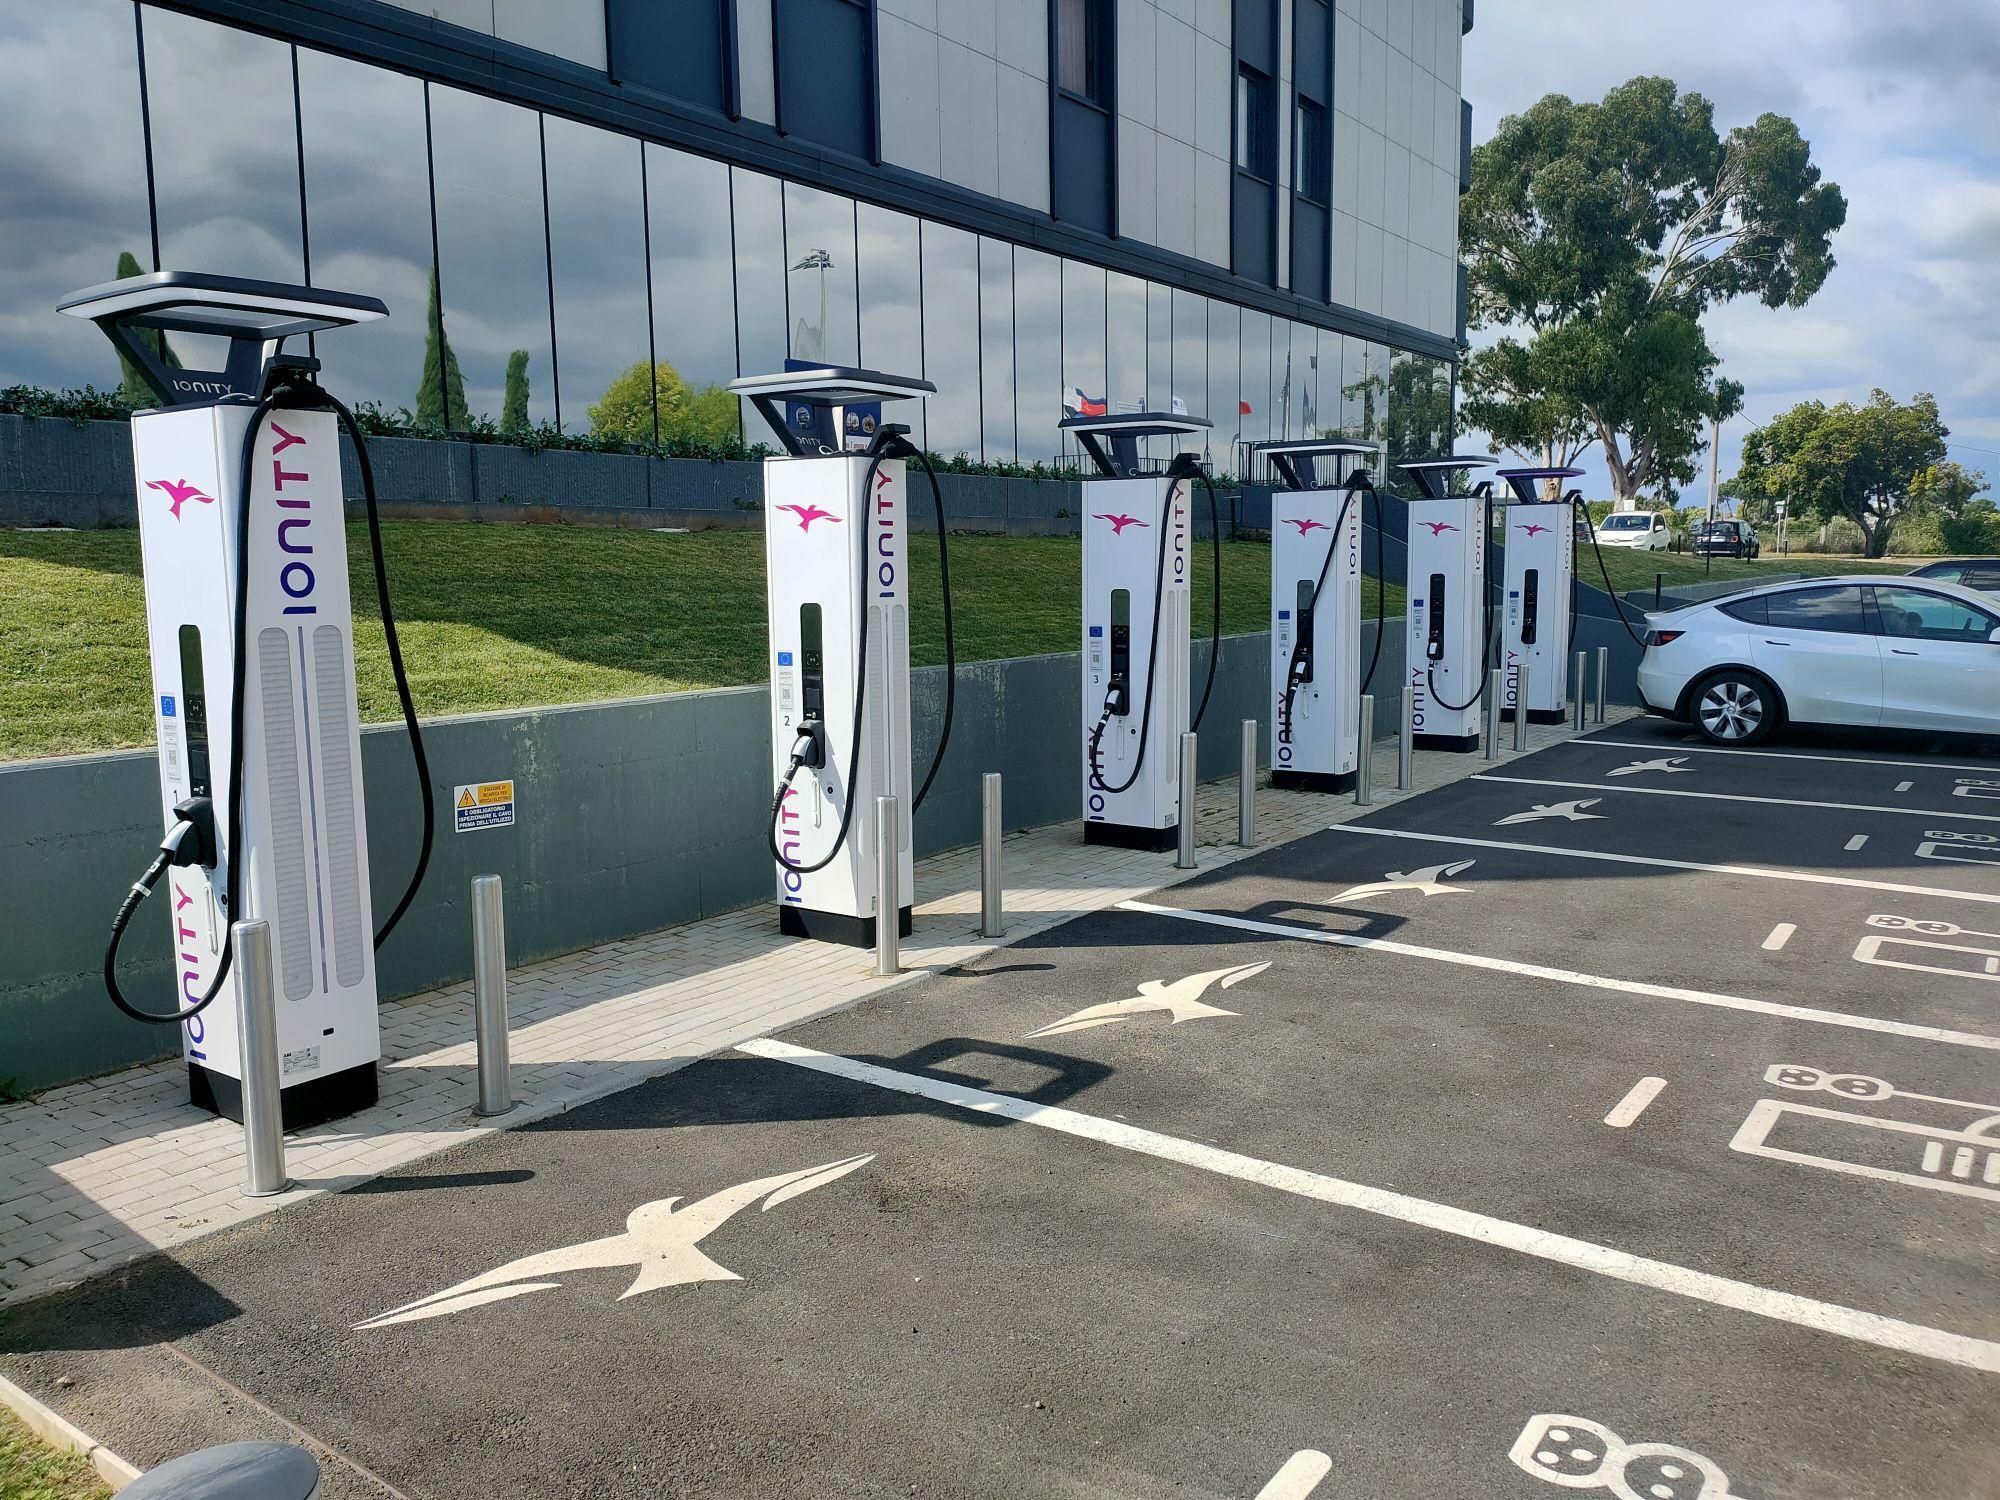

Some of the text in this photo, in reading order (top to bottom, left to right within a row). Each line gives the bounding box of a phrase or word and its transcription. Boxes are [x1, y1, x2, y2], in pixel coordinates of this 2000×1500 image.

[173, 380, 232, 394] IONITY
[271, 421, 317, 615] IONITY
[876, 467, 895, 598] IONITY
[1174, 485, 1185, 583] IONITY
[1349, 497, 1357, 575] IONITY
[1093, 674, 1099, 684] 3
[1506, 650, 1519, 708] IONITY
[1412, 667, 1425, 732] IONITY
[784, 715, 790, 727] 2
[173, 789, 179, 805] 1
[469, 806, 505, 815] OBBLIGATORIO
[459, 813, 492, 823] ISPEZIONARE
[459, 816, 512, 829] PRIMA DELL'UTILIZZO
[175, 882, 207, 1061] IONITY
